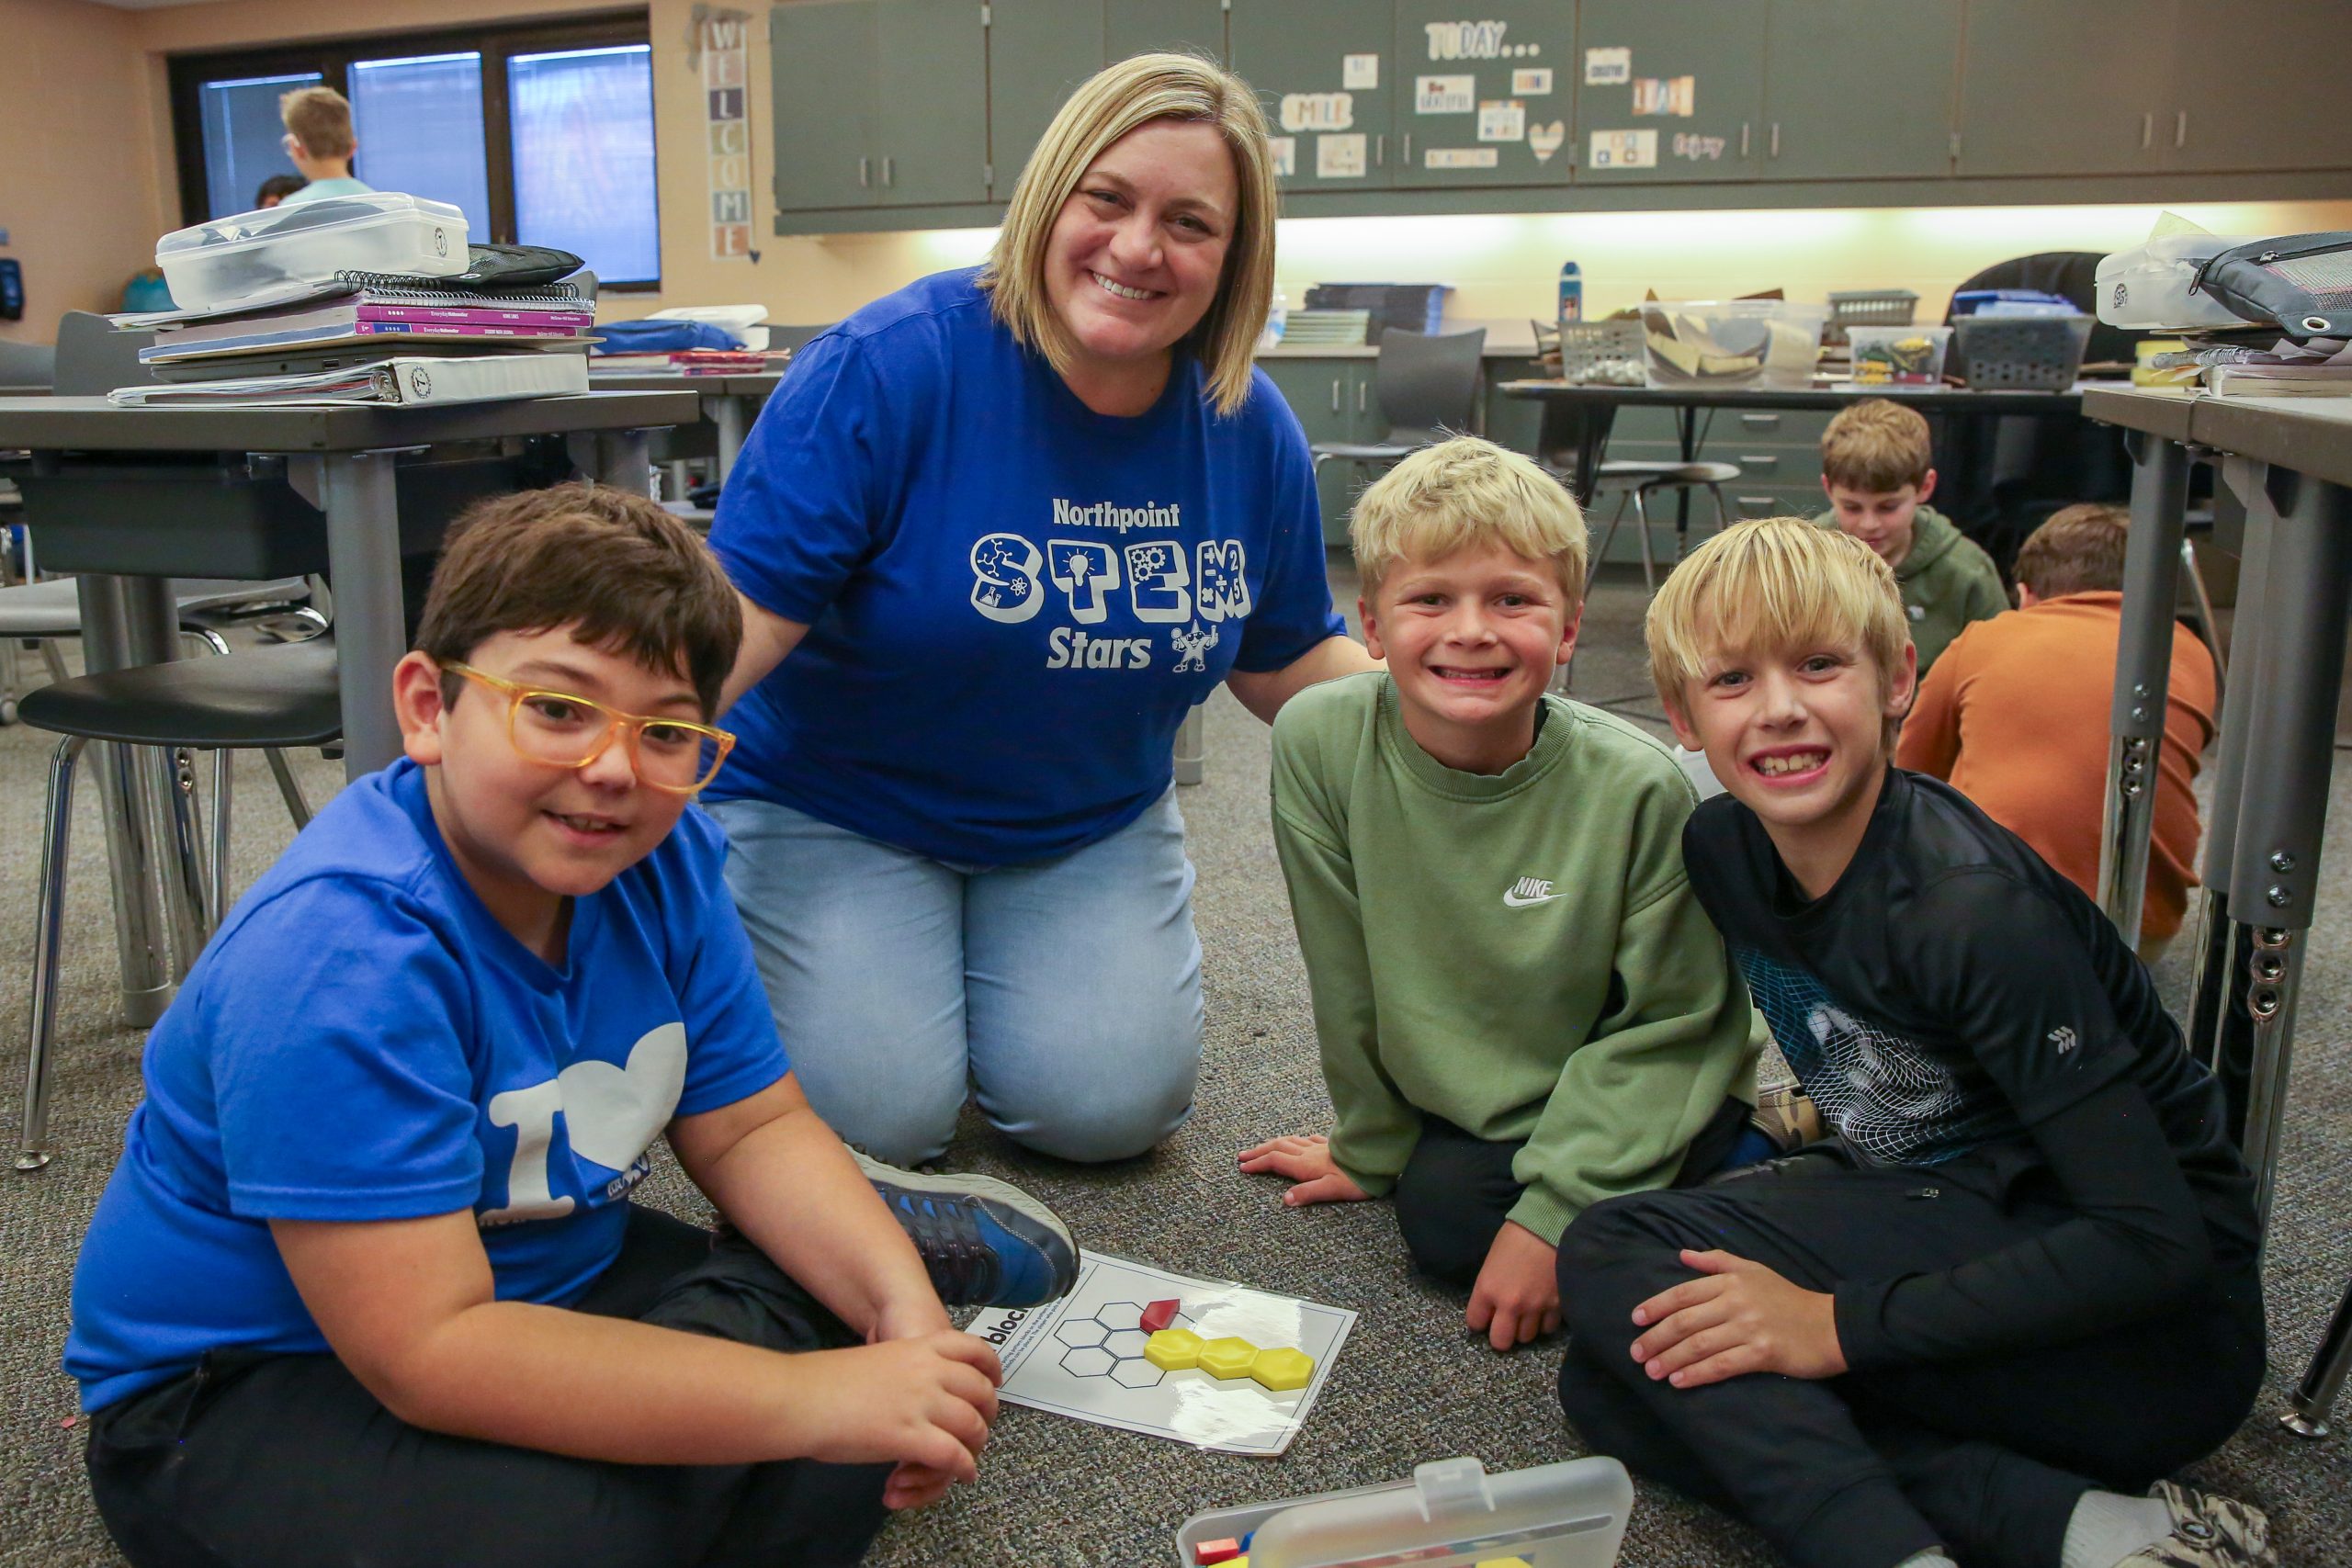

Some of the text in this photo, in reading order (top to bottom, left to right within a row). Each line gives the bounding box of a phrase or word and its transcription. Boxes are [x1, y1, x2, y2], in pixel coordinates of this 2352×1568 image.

[1053, 498, 1180, 534] Northpoint
[970, 533, 1252, 625] STEM
[1046, 626, 1152, 669] Stars
[1513, 876, 1554, 897] NIKE
[980, 1308, 1029, 1346] bloc
